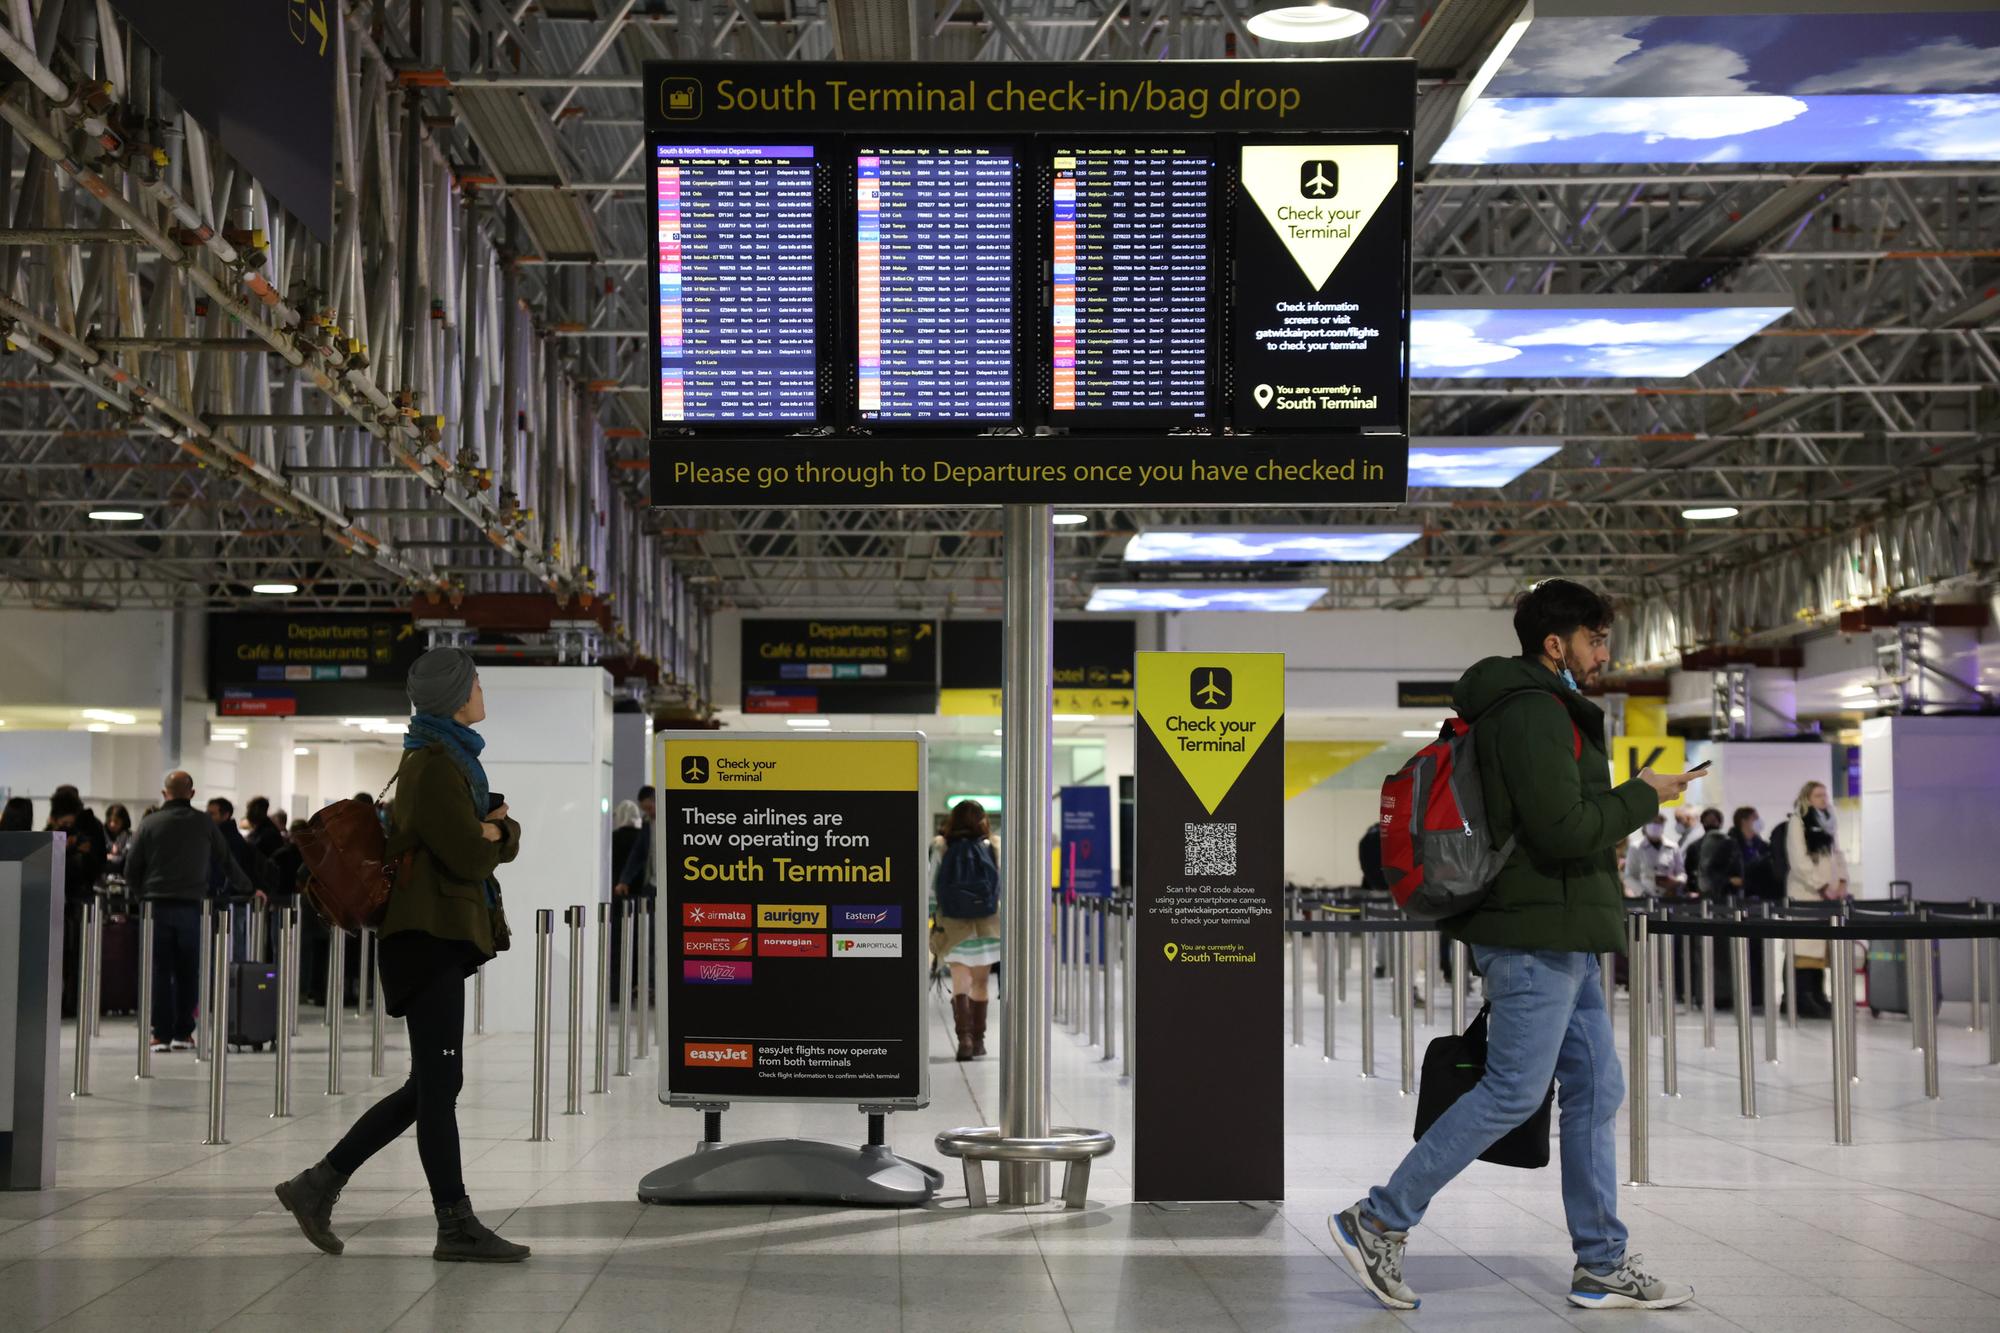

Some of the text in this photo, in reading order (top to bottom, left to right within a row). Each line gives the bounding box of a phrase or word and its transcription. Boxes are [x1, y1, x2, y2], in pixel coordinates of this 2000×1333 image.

[717, 79, 1300, 118] South Terminal check-in/bag drop
[1277, 205, 1361, 224] Check your
[1288, 225, 1351, 239] Terminal
[1276, 302, 1359, 312] Check information
[1284, 315, 1350, 324] screens or visit
[1256, 327, 1379, 339] gatwickairport.com/flights
[1267, 340, 1367, 352] to check your terminal
[1277, 386, 1292, 394] You
[1313, 385, 1351, 396] currently
[1352, 385, 1361, 394] in
[1277, 396, 1377, 409] South Terminal
[674, 458, 1384, 488] Please go through to Departures once you have checked in
[288, 624, 367, 639] Departures
[809, 623, 887, 638] Departures
[237, 644, 368, 660] Café & restaurants
[810, 645, 887, 658] restaurants
[1053, 668, 1084, 682] otel
[1166, 716, 1256, 736] Check your
[1177, 737, 1245, 752] Terminal
[717, 759, 776, 772] Check your
[717, 772, 762, 782] Terminal
[682, 808, 842, 825] These airlines are
[683, 830, 869, 851] now operating from
[683, 856, 891, 882] South Terminal
[1156, 897, 1174, 905] using
[1195, 897, 1237, 905] smartphone
[708, 911, 746, 920] airmalta
[764, 908, 819, 925] aurigny
[846, 912, 875, 920] Eastern
[1175, 907, 1272, 916] gatwickairport.com/flights
[1208, 944, 1235, 952] currently
[1181, 953, 1256, 962] South Terminal
[690, 1049, 748, 1062] easyJet
[759, 1046, 793, 1055] easyJet
[796, 1046, 825, 1056] flights
[850, 1048, 887, 1057] operate
[759, 1057, 851, 1066] from both terminals
